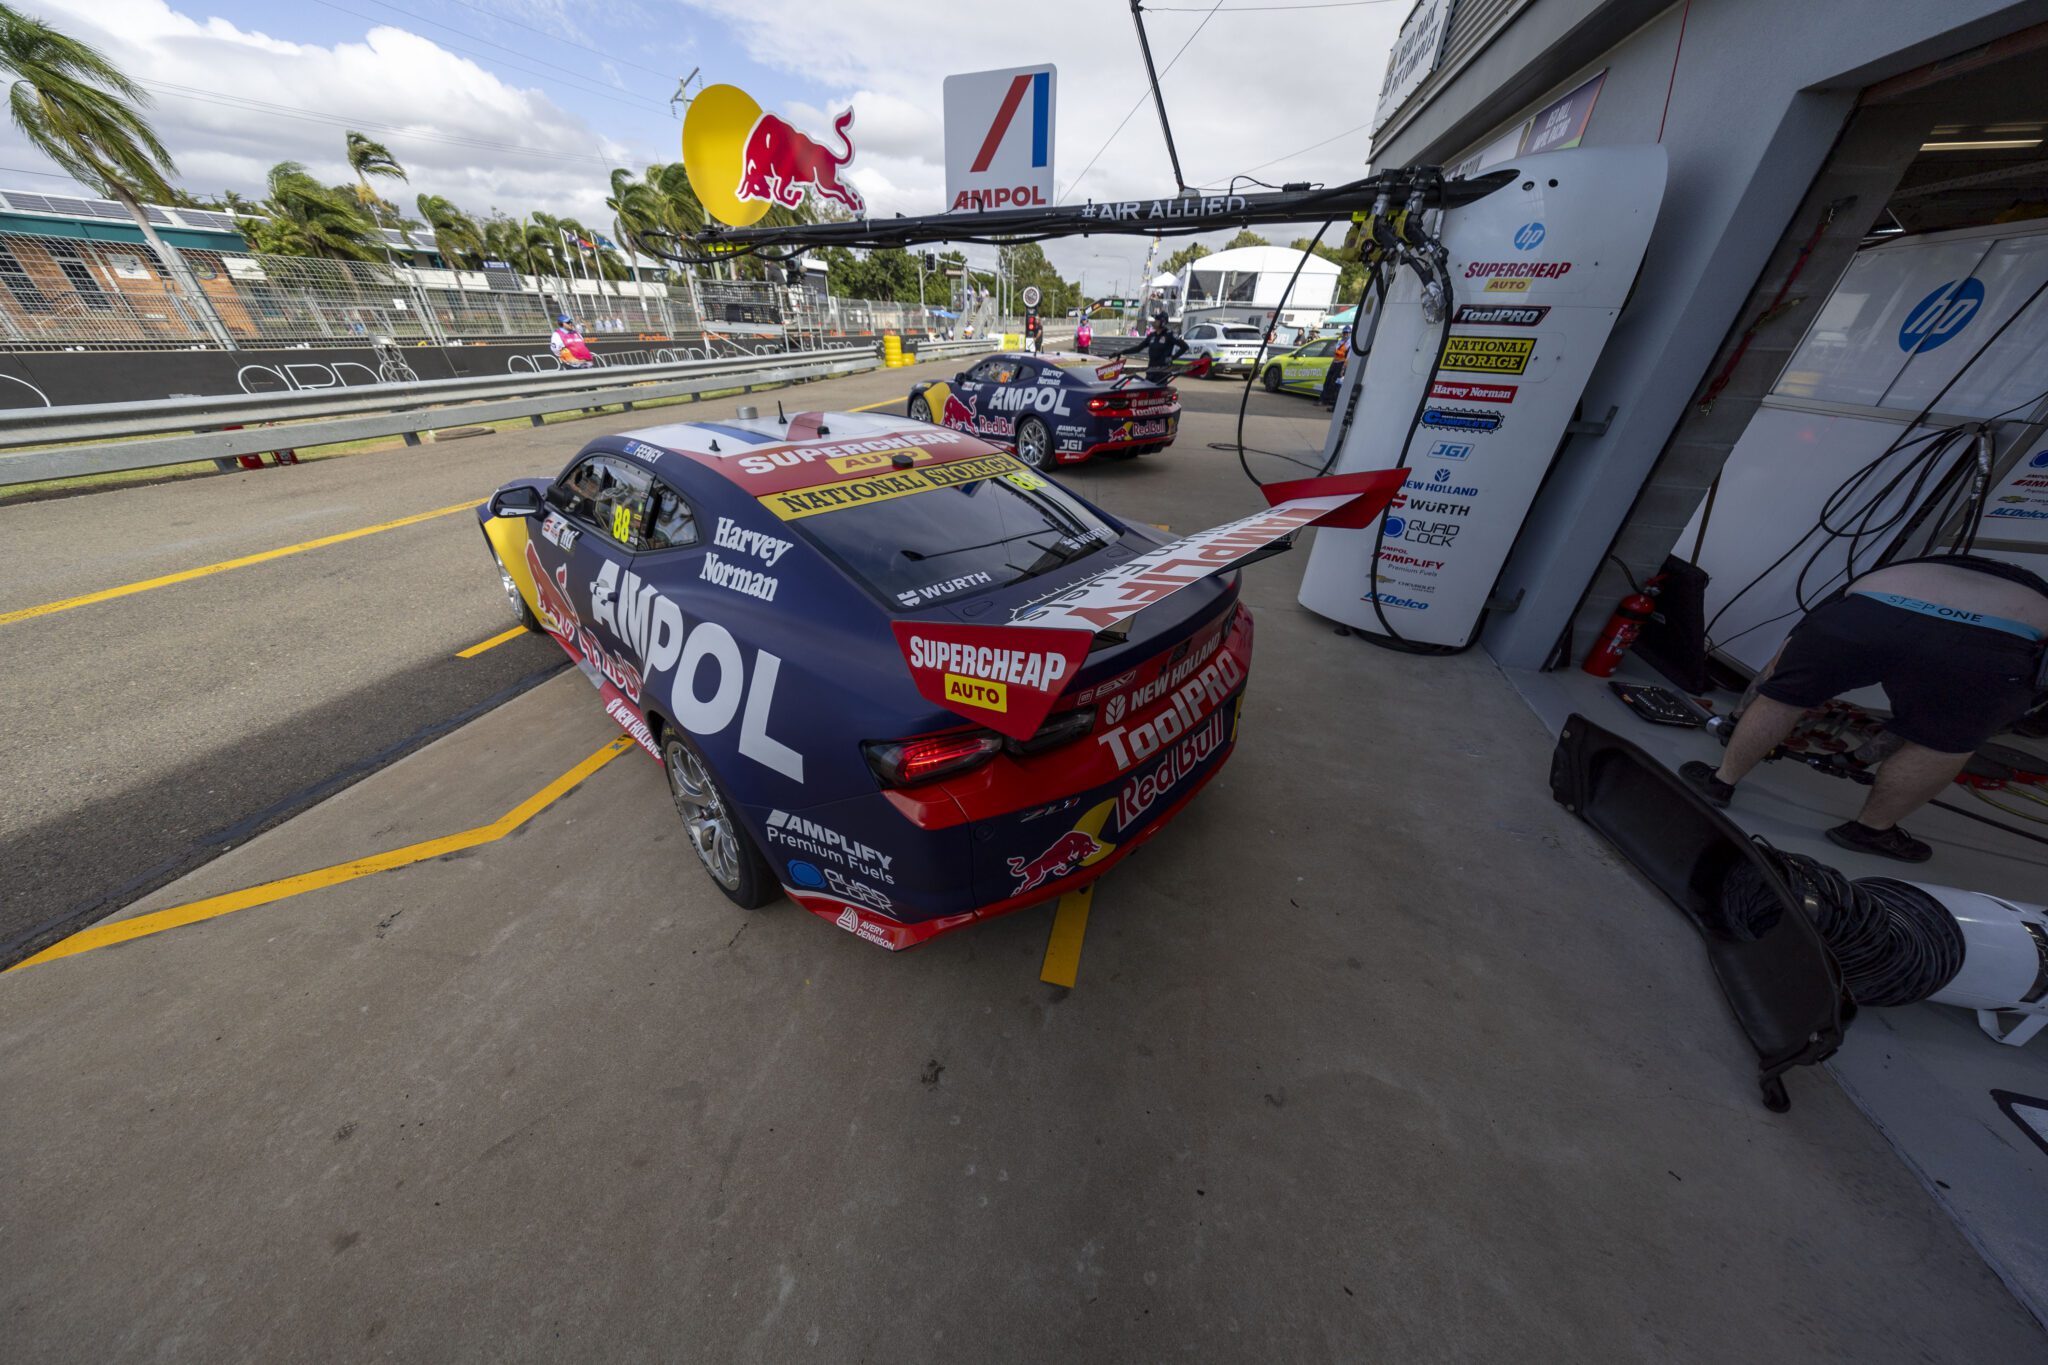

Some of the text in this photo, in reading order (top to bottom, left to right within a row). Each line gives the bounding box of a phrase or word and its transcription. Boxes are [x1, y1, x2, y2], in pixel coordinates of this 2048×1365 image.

[1401, 20, 1440, 84] COMPLEX
[953, 186, 1046, 210] AMPOL
[1150, 196, 1245, 219] ALLIED
[1514, 222, 1546, 250] hp
[1465, 262, 1572, 279] SUPERCHEAP
[1489, 281, 1526, 290] AUTO
[1460, 309, 1539, 323] ToolPRO
[1901, 278, 1982, 353] hp
[1449, 340, 1528, 352] NATIONAL
[1447, 354, 1519, 368] STORAGE
[1037, 376, 1060, 386] Norman
[1042, 367, 1064, 379] Harvey
[988, 387, 1071, 416] AMPOL
[1433, 384, 1511, 399] Harvey Norman
[979, 415, 998, 434] Red
[1061, 425, 1086, 433] AMPLIFY
[1133, 419, 1165, 436] Red Bull
[634, 444, 664, 464] FEENEY
[738, 431, 963, 474] SUPERCHEAP
[1060, 439, 1082, 450] JGI
[1431, 444, 1469, 458] JGI
[924, 459, 1021, 484] STORAGE
[1006, 472, 1048, 491] 88
[777, 475, 927, 512] NATIONAL
[1425, 483, 1478, 496] HOLLAND
[613, 504, 630, 543] 88
[1408, 520, 1460, 536] QUAD
[714, 517, 794, 567] Harvey
[1404, 531, 1455, 547] LOCK
[1382, 546, 1408, 554] AMPOL
[1380, 552, 1445, 570] AMPLIFY
[1388, 564, 1418, 574] Premium
[699, 552, 778, 602] Norman
[1938, 608, 1983, 622] ONE
[590, 559, 804, 784] AMPOL
[910, 635, 1067, 692] SUPERCHEAP
[1130, 671, 1170, 712] NEW
[1171, 632, 1220, 687] HOLLAND
[951, 681, 1000, 705] AUTO
[613, 706, 637, 728] NEW
[1097, 650, 1240, 771] ToolPRO
[1116, 707, 1224, 832] Red Bull
[785, 814, 893, 870] AMPLIFY
[767, 827, 895, 885] Premium Fuels
[859, 921, 885, 936] AVERY
[856, 928, 895, 951] DENNISON
